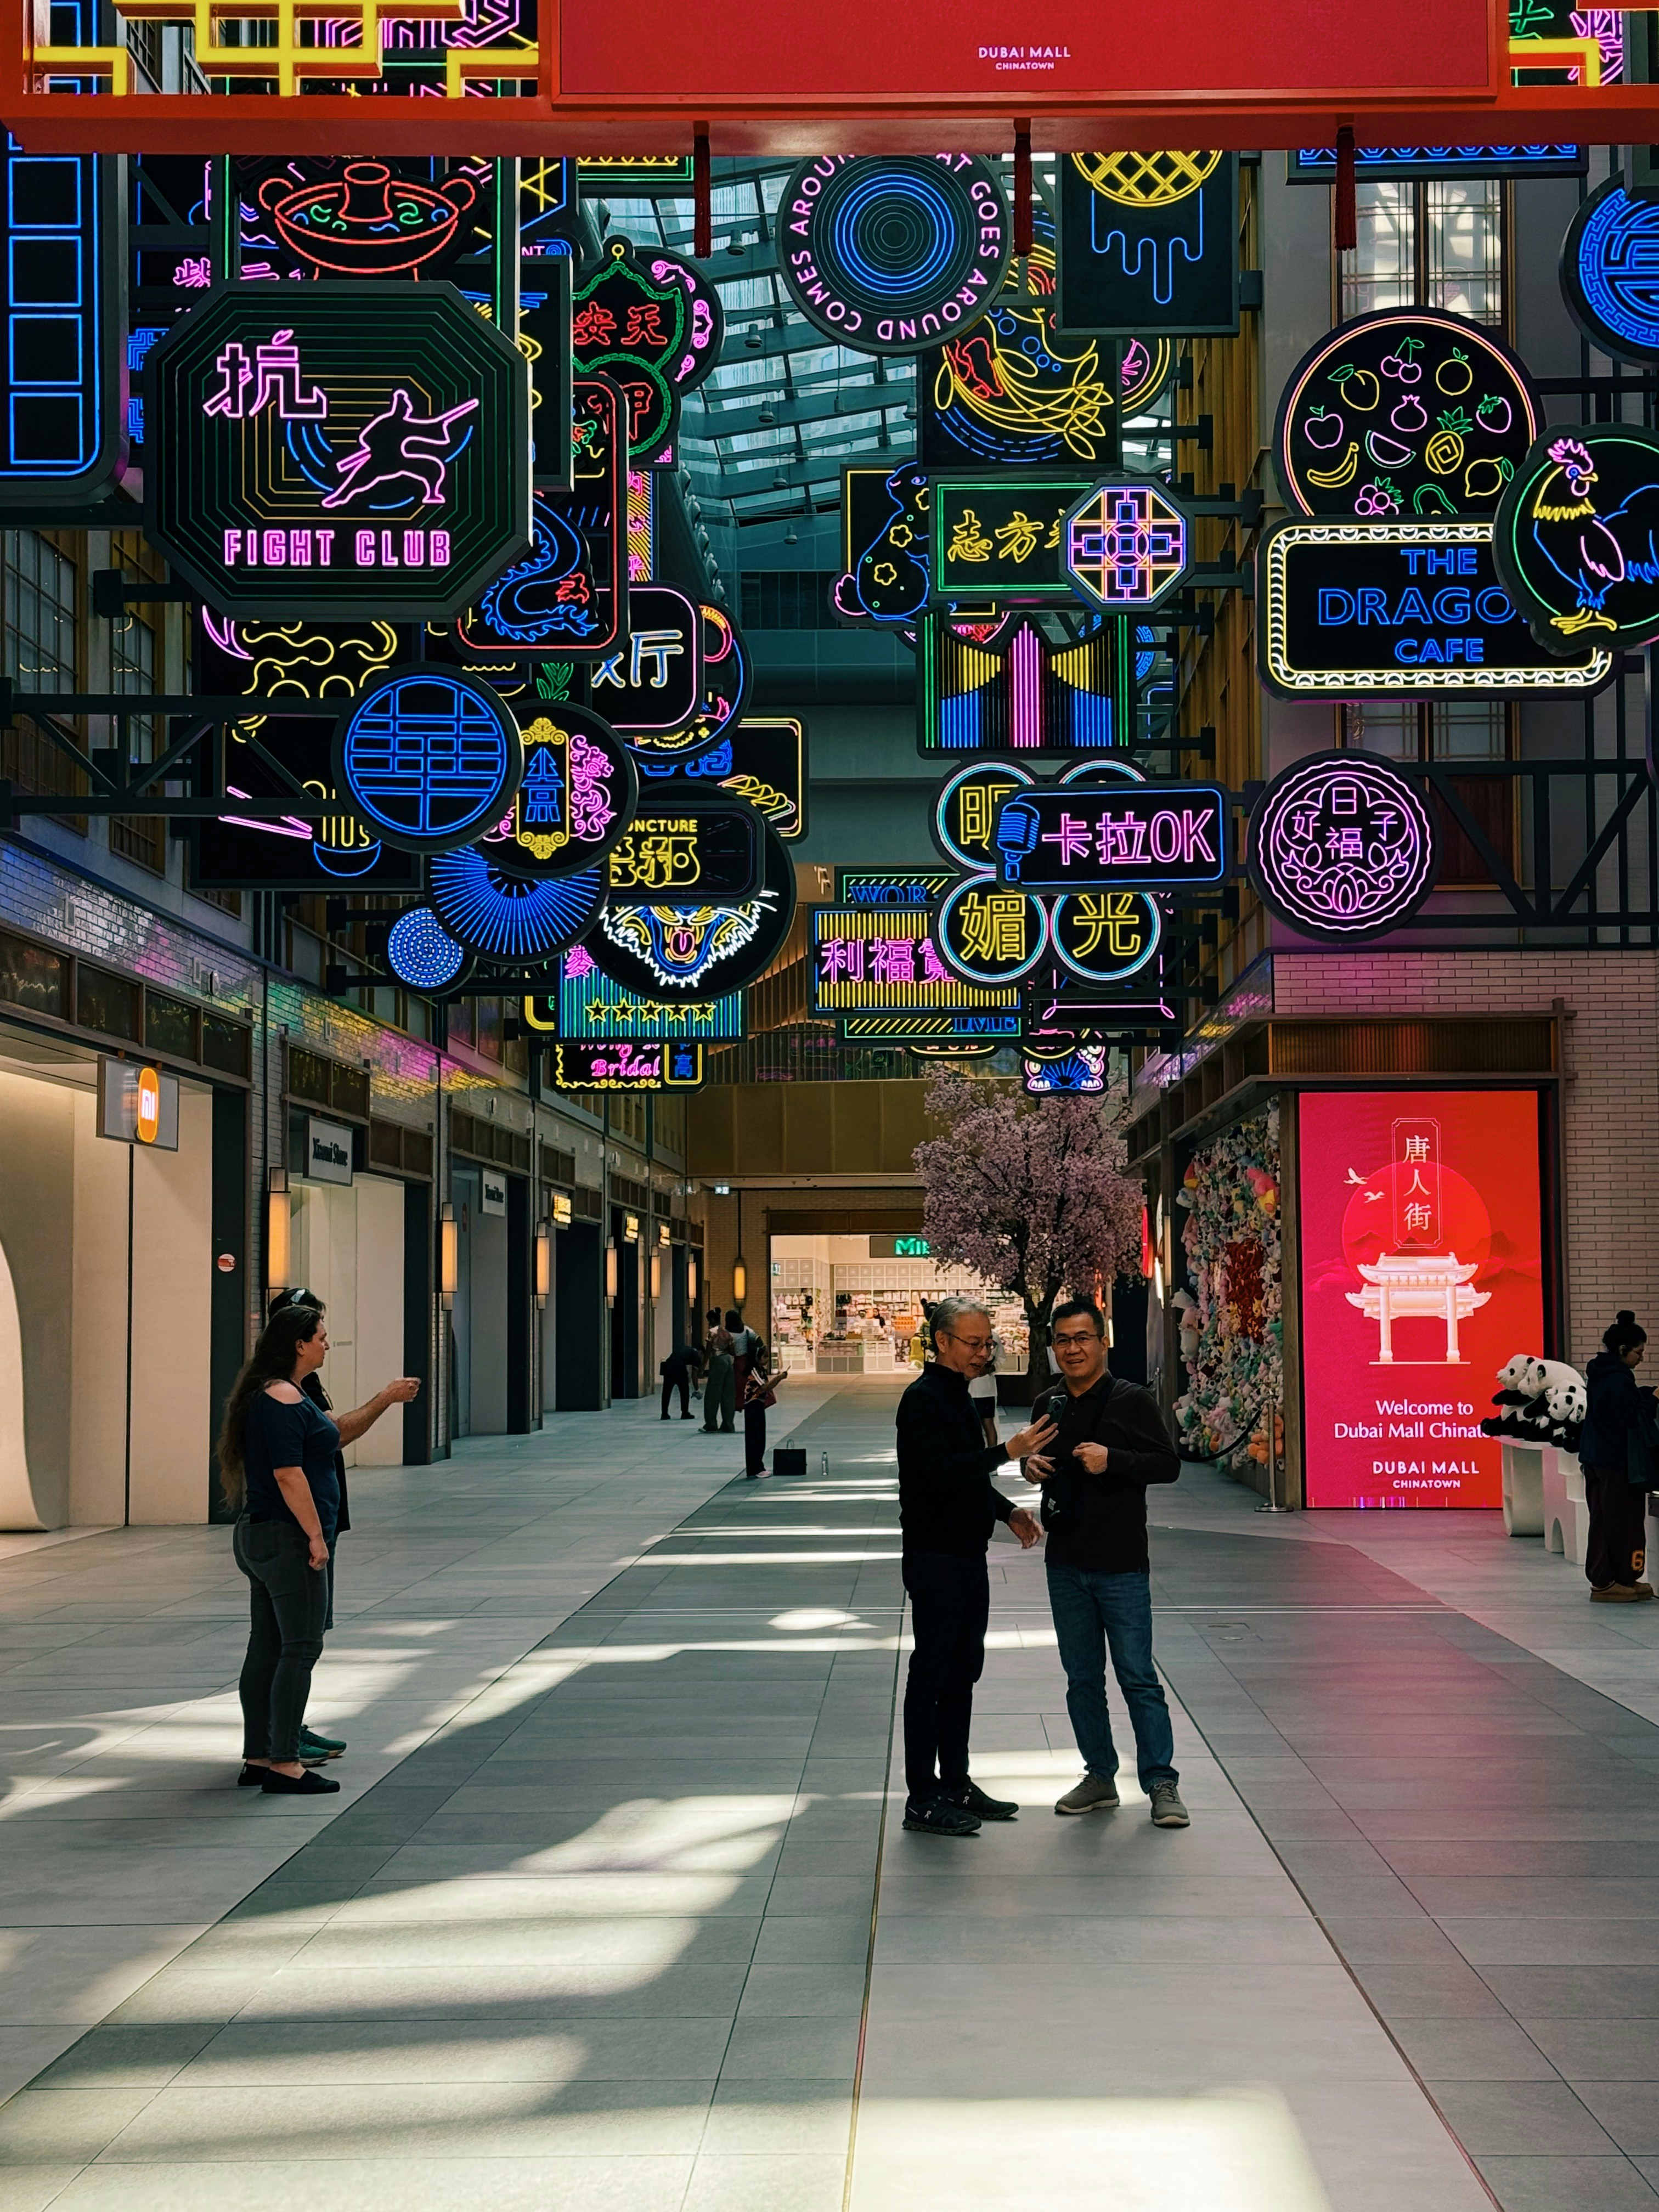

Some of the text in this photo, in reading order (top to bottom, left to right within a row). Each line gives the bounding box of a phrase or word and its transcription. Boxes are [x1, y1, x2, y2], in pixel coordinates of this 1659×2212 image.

[978, 47, 1071, 58] DUBAI MALL
[995, 62, 1055, 70] CHINATOWN
[788, 153, 855, 236] AROU
[970, 181, 1001, 259] GOES
[791, 250, 863, 332] COMES
[877, 268, 989, 341] AROUND
[203, 329, 328, 419] 抗
[224, 529, 451, 567] FIGHT CLUB
[947, 509, 1060, 563] 志方
[1400, 548, 1478, 575] THE
[1318, 586, 1528, 626] DRAGO
[1394, 637, 1485, 663] CAFE
[1041, 809, 1216, 866] 卡拉OK
[1324, 826, 1363, 860] 福
[850, 885, 939, 904] WOR
[590, 1054, 661, 1077] Bridal
[1403, 1134, 1431, 1232] 唐人街
[1375, 1399, 1474, 1415] Welcome to
[1334, 1421, 1383, 1438] Dubai
[1388, 1421, 1424, 1438] Mall
[1373, 1460, 1480, 1475] DUBAI MALL
[1392, 1479, 1461, 1489] CHINATOWN
